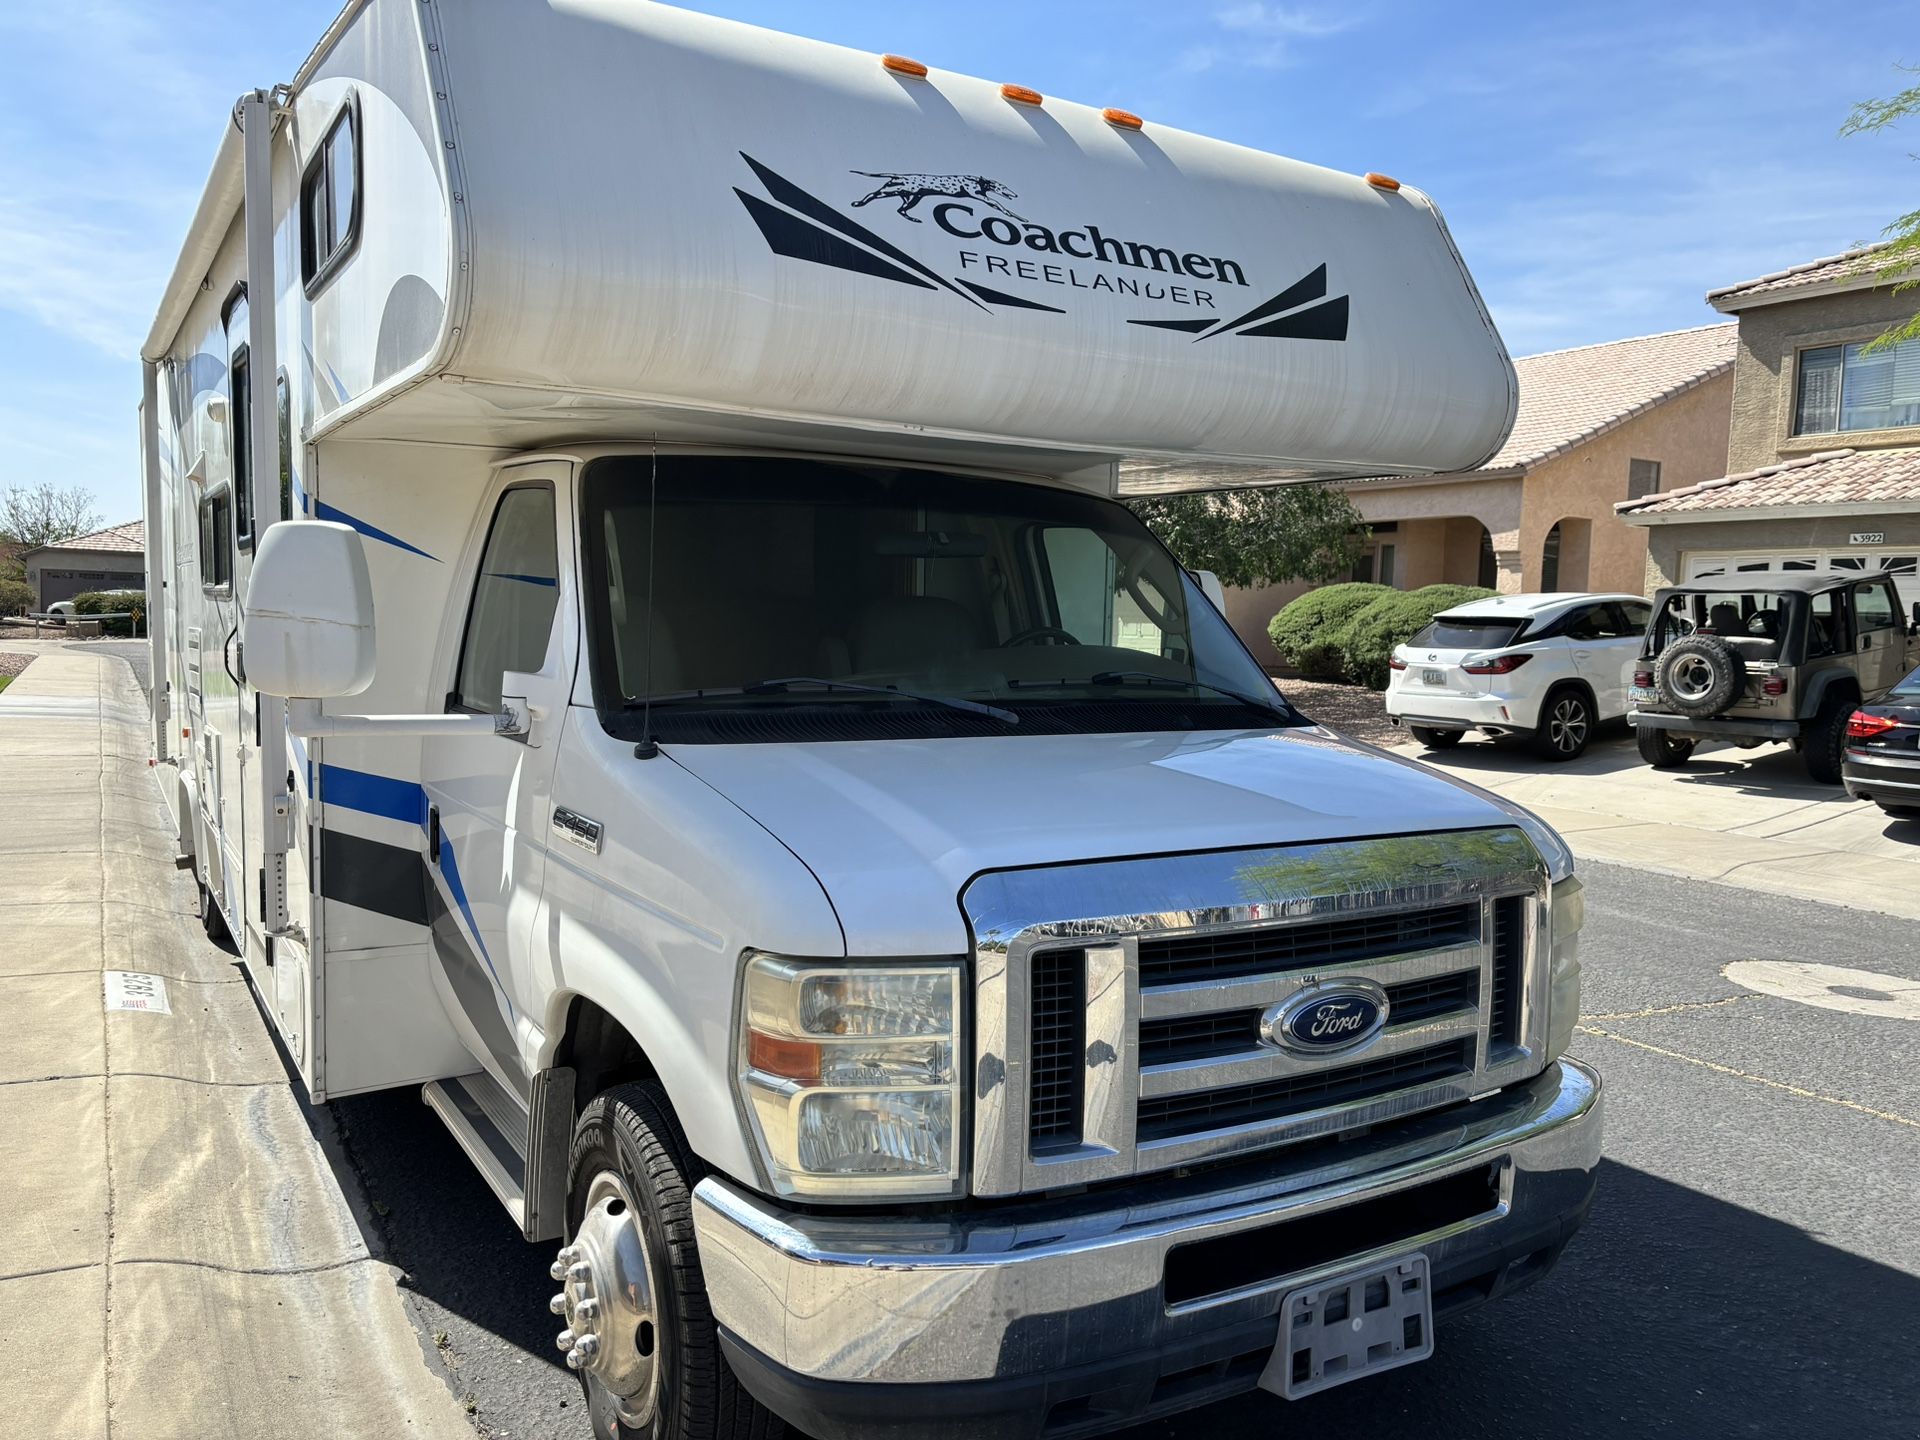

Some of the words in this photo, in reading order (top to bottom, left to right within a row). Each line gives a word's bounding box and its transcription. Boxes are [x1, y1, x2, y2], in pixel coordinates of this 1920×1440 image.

[932, 202, 1250, 287] Coachmen
[960, 250, 1217, 309] FREELANDER
[1860, 534, 1882, 543] 3922
[122, 973, 155, 997] 3925
[1311, 1002, 1364, 1037] Ford
